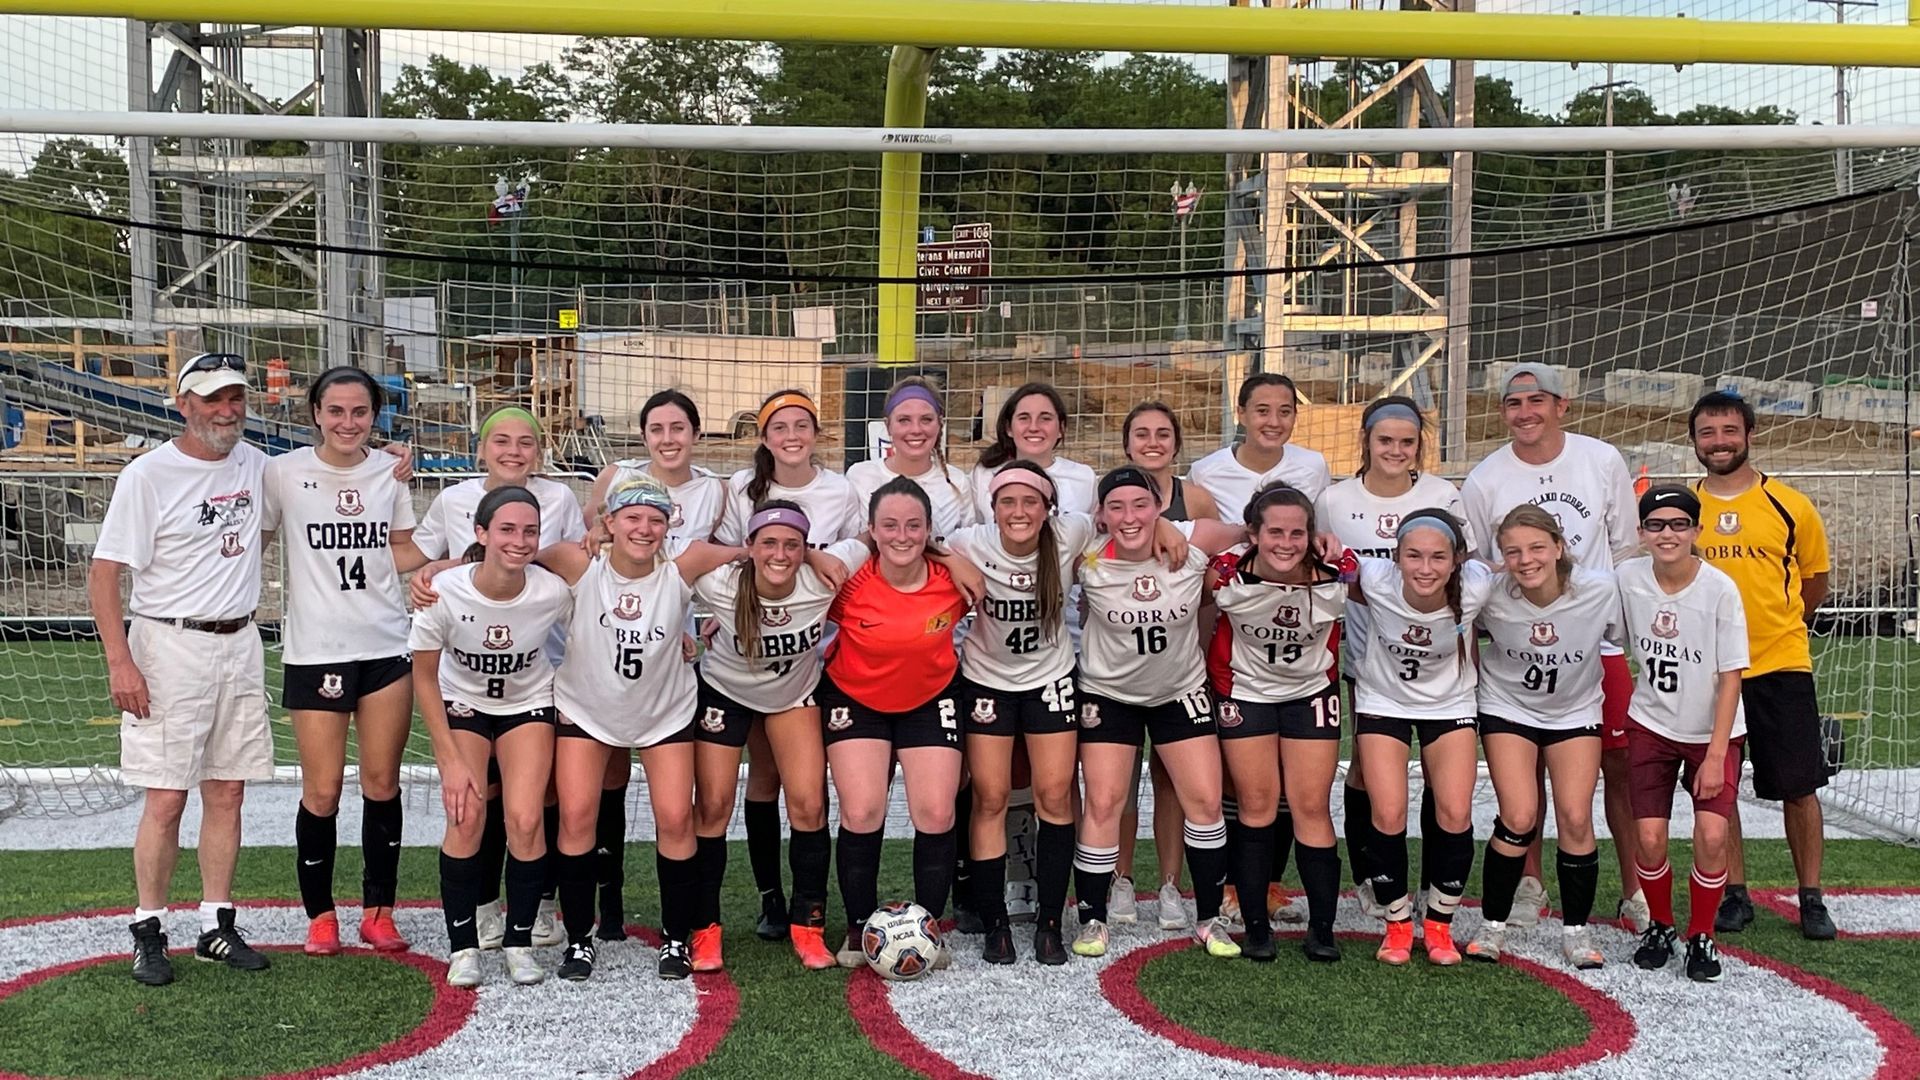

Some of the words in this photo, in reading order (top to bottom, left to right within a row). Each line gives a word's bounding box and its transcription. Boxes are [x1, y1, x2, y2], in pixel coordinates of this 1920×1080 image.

[973, 227, 989, 239] 106
[917, 252, 942, 261] terans
[947, 248, 985, 260] Memorial
[919, 266, 940, 276] Civic
[944, 265, 972, 275] Center
[926, 297, 942, 305] NEXT
[306, 521, 388, 550] COBRAS
[1705, 545, 1767, 560] OBRAS
[336, 555, 366, 591] 14
[1107, 603, 1189, 625] COBRAS
[599, 612, 665, 645] CBRAS
[1005, 626, 1040, 654] 42
[1131, 625, 1167, 655] 16
[453, 647, 539, 675] COBRAS
[614, 643, 643, 680] 15
[1263, 643, 1303, 664] 19
[1506, 648, 1584, 666] COBRAS
[1399, 658, 1420, 681] 3
[1521, 664, 1558, 694] 91
[1646, 657, 1679, 693] 15
[487, 678, 505, 698] 8
[1041, 677, 1075, 712] 42
[938, 698, 957, 729] 2
[1179, 686, 1211, 719] 16
[1311, 695, 1340, 728] 19
[893, 931, 915, 941] NCAA
